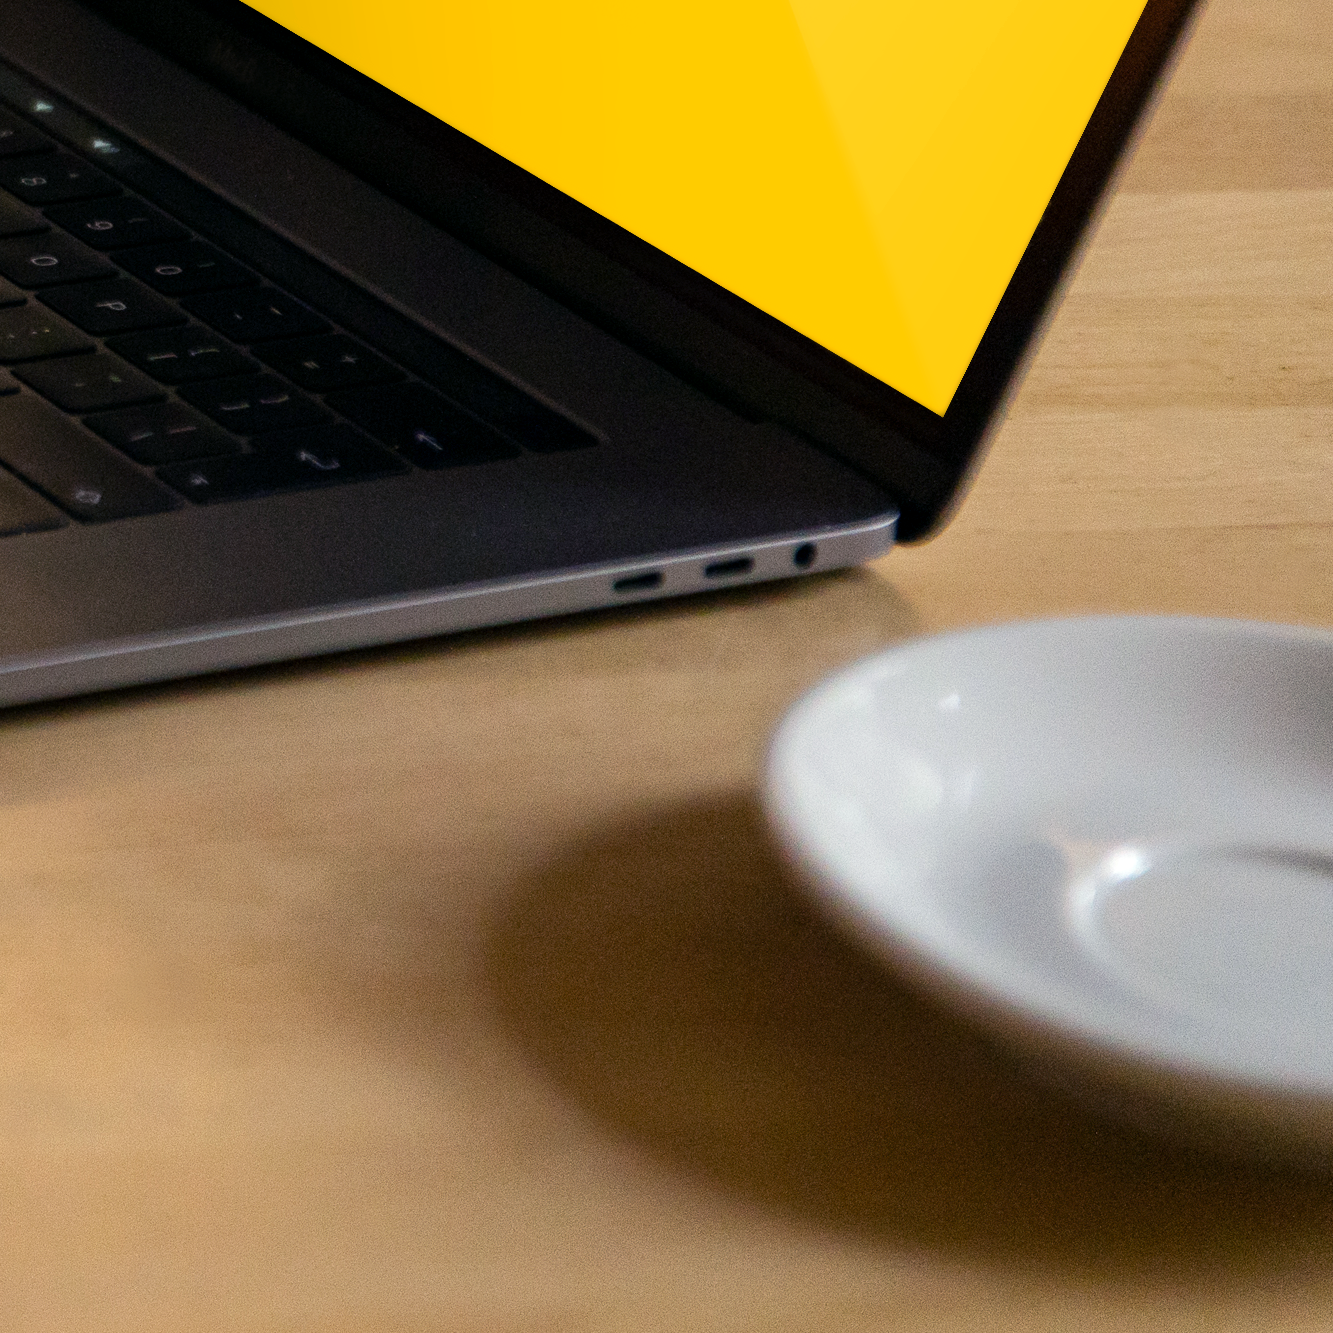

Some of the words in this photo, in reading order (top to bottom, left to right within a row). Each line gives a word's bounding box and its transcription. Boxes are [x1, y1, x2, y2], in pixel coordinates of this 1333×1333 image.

[20, 176, 47, 187] 8
[86, 220, 114, 232] 9
[95, 300, 127, 311] P
